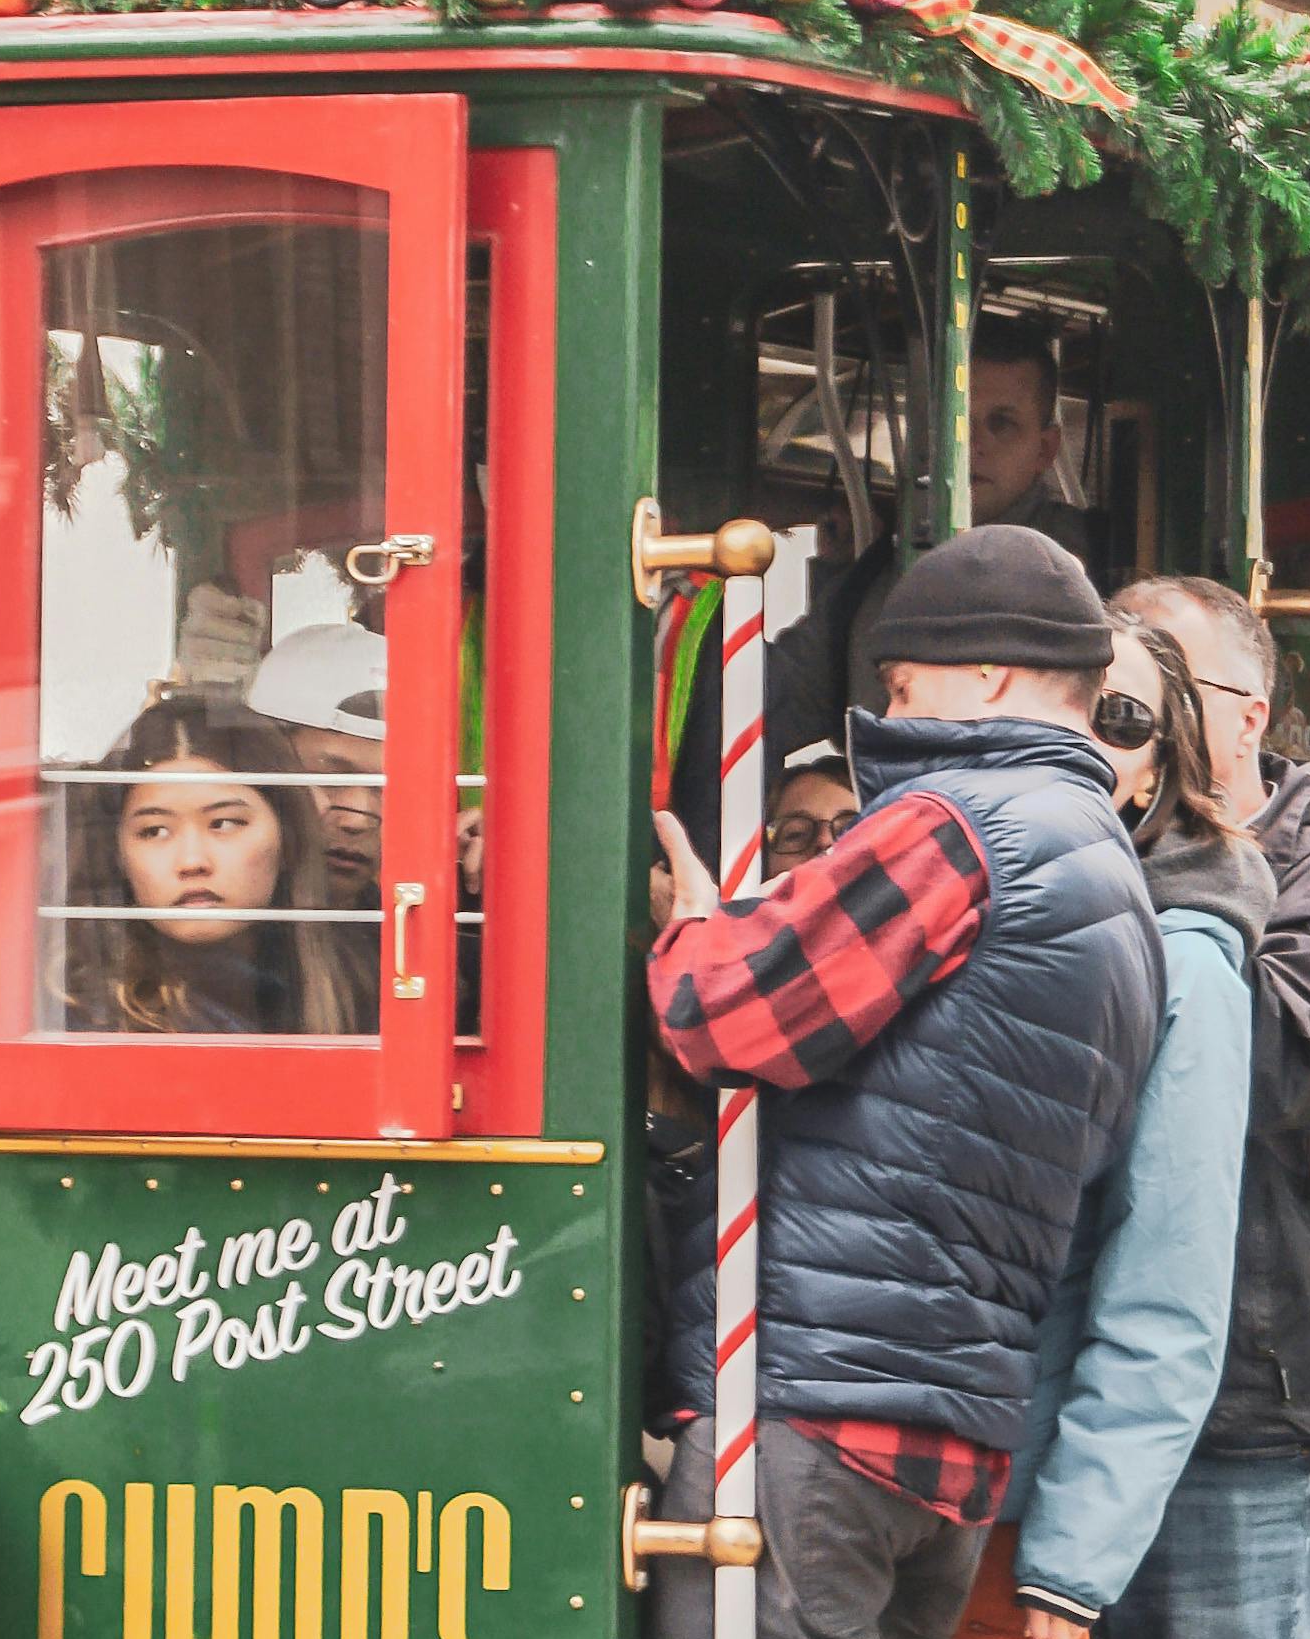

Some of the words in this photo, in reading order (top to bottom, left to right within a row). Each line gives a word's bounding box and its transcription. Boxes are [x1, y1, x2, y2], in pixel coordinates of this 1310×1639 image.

[20, 1319, 157, 1425] 250
[171, 1282, 311, 1382] Post
[317, 1225, 522, 1341] Street
[55, 1227, 208, 1332] Meet
[218, 1219, 320, 1291] me
[332, 1173, 408, 1252] at
